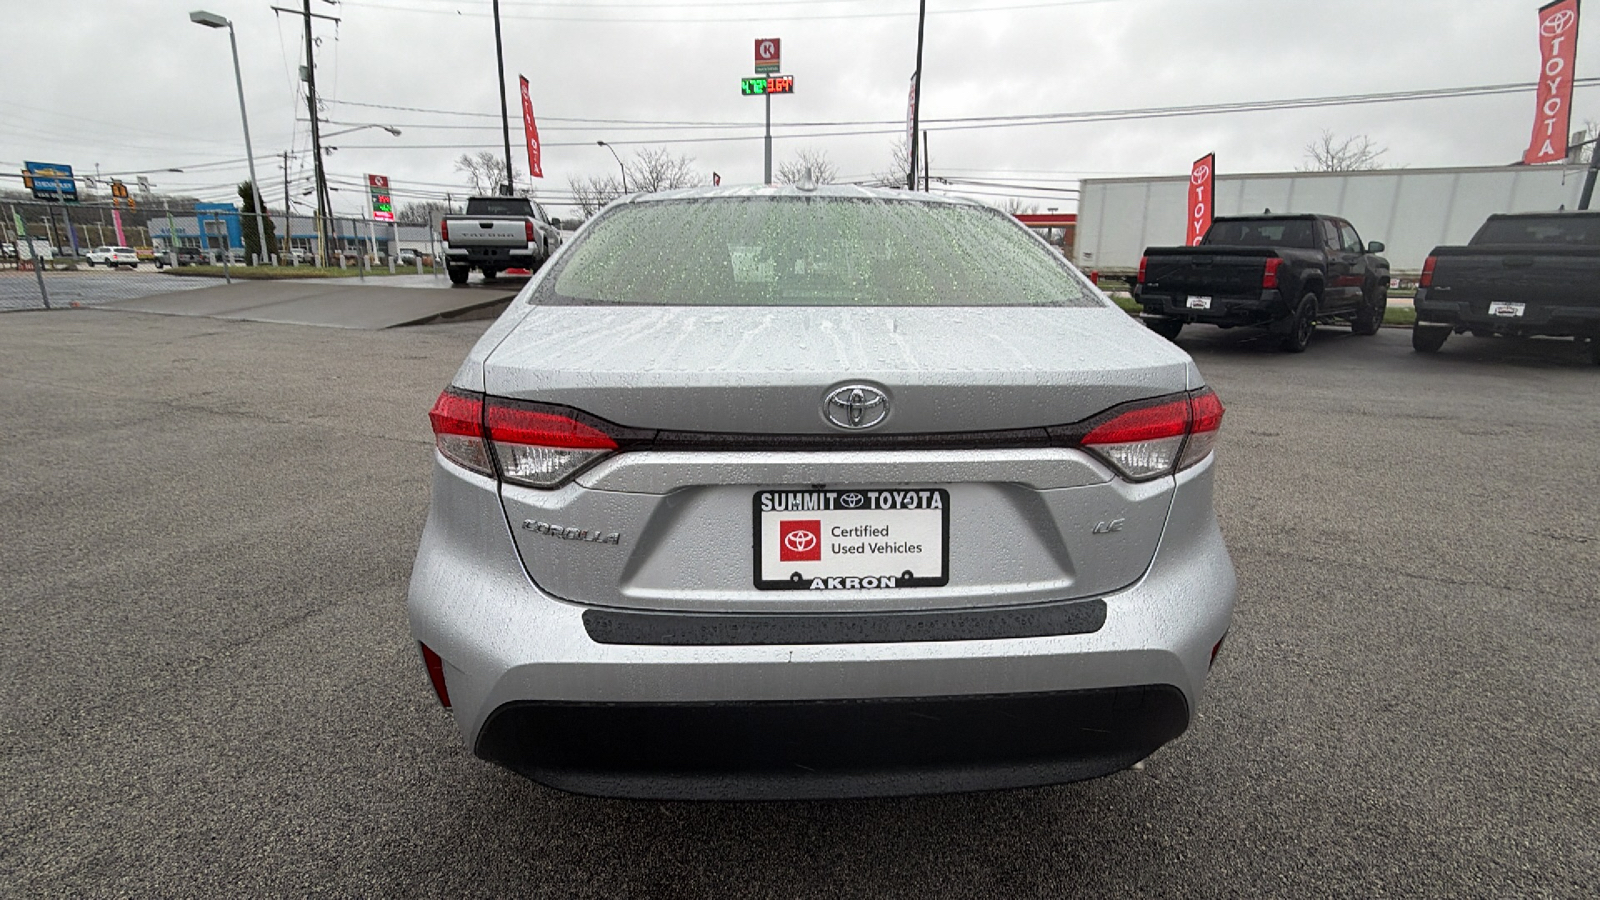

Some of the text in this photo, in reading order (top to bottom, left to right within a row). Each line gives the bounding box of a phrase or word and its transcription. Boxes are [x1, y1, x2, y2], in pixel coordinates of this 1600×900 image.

[1538, 37, 1564, 157] TOYOTA
[761, 491, 943, 511] SUMMIT TOYOTA
[522, 519, 620, 545] COROLLA
[831, 525, 889, 538] Certified
[1092, 517, 1126, 535] LE
[831, 542, 923, 555] Used Vehicles
[810, 576, 896, 590] AKRON
